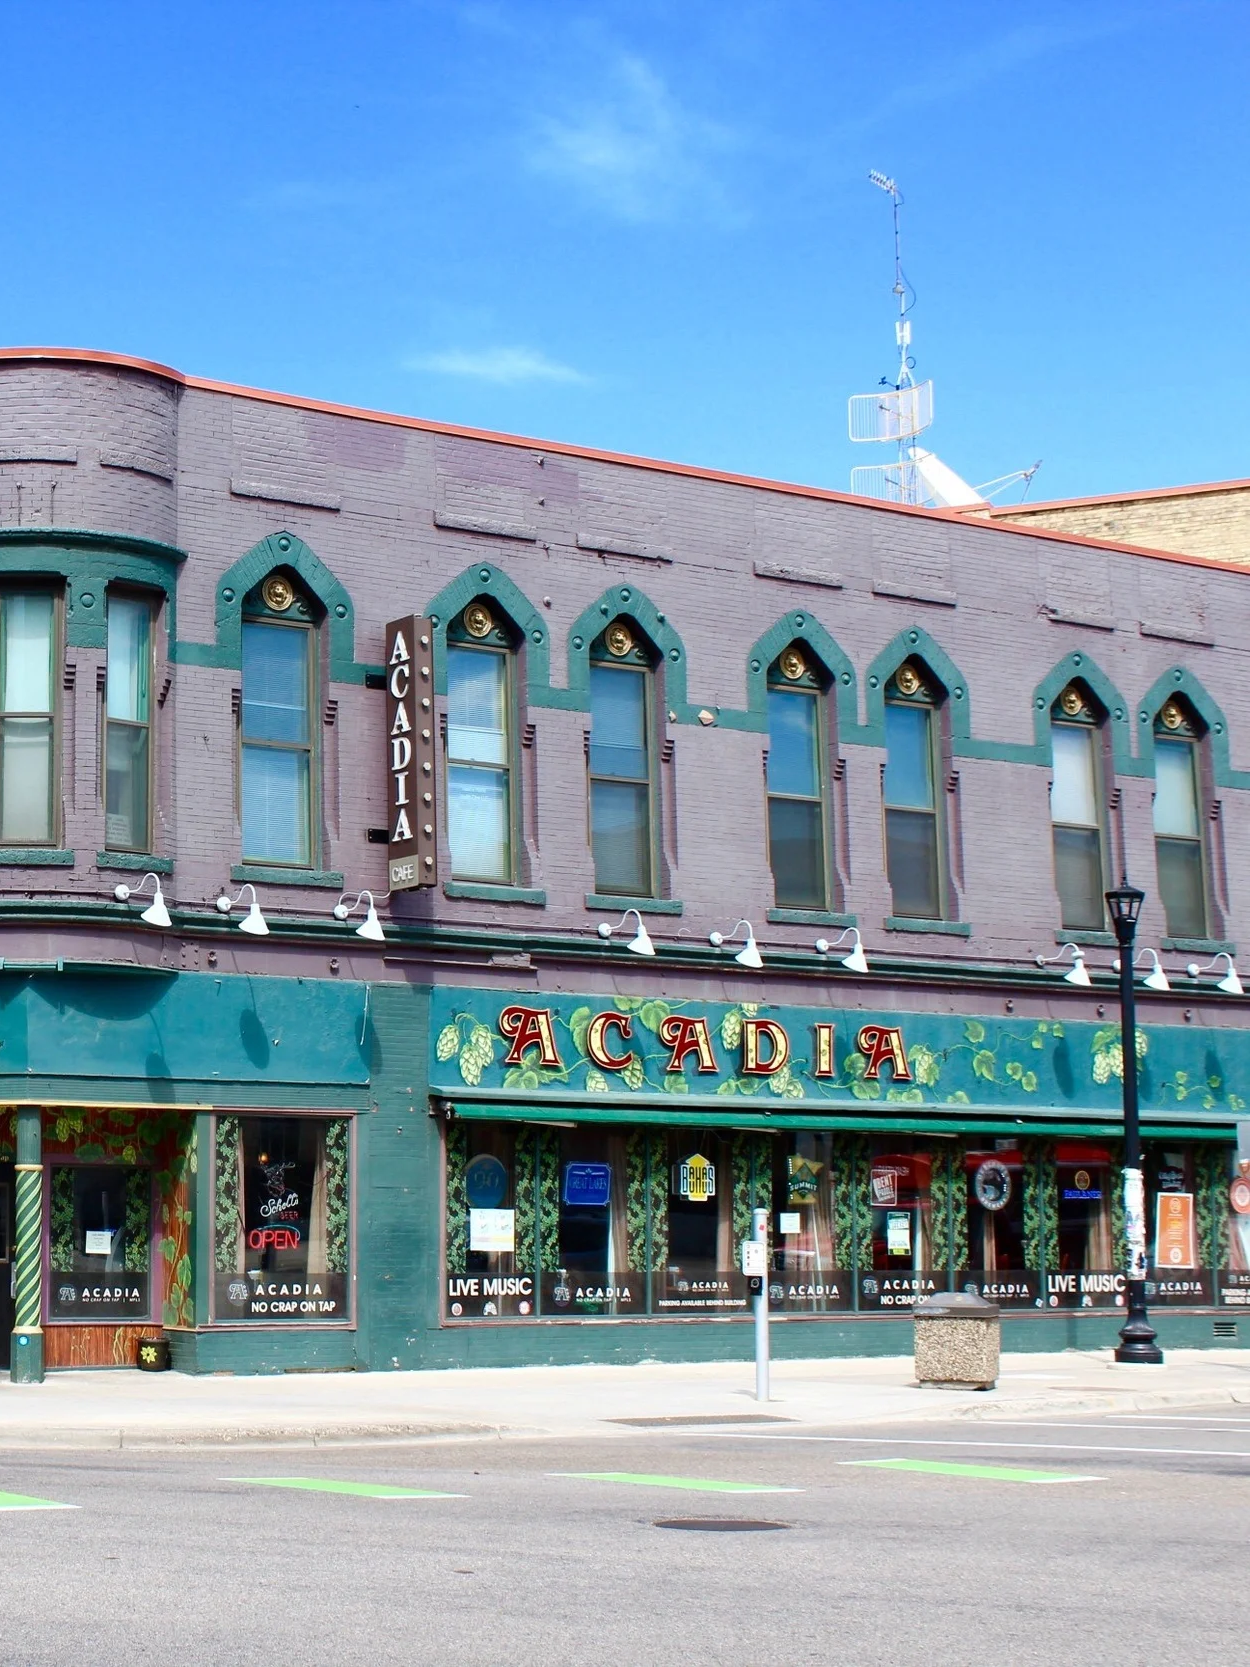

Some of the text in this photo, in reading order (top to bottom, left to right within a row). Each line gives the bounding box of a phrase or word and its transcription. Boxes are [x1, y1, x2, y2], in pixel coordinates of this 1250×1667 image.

[389, 630, 413, 842] ACADIA
[498, 1005, 914, 1081] ACADIA
[790, 1181, 818, 1192] SUMMIT
[280, 1211, 299, 1220] BEER
[249, 1230, 298, 1250] OPEN
[449, 1277, 532, 1296] LIVE MUSIC
[883, 1280, 935, 1290] ACADIA
[1048, 1274, 1126, 1292] LIVE MUSIC
[1159, 1282, 1203, 1291] ACADIA
[82, 1288, 140, 1297] ACADIA
[255, 1284, 322, 1296] ACADIA
[576, 1287, 631, 1297] ACADIA
[789, 1285, 839, 1295] ACADIA
[982, 1284, 1029, 1293] ACADIA
[880, 1295, 894, 1305] NO
[895, 1295, 917, 1304] CRAP
[251, 1301, 336, 1313] NO CRAP ON TAP
